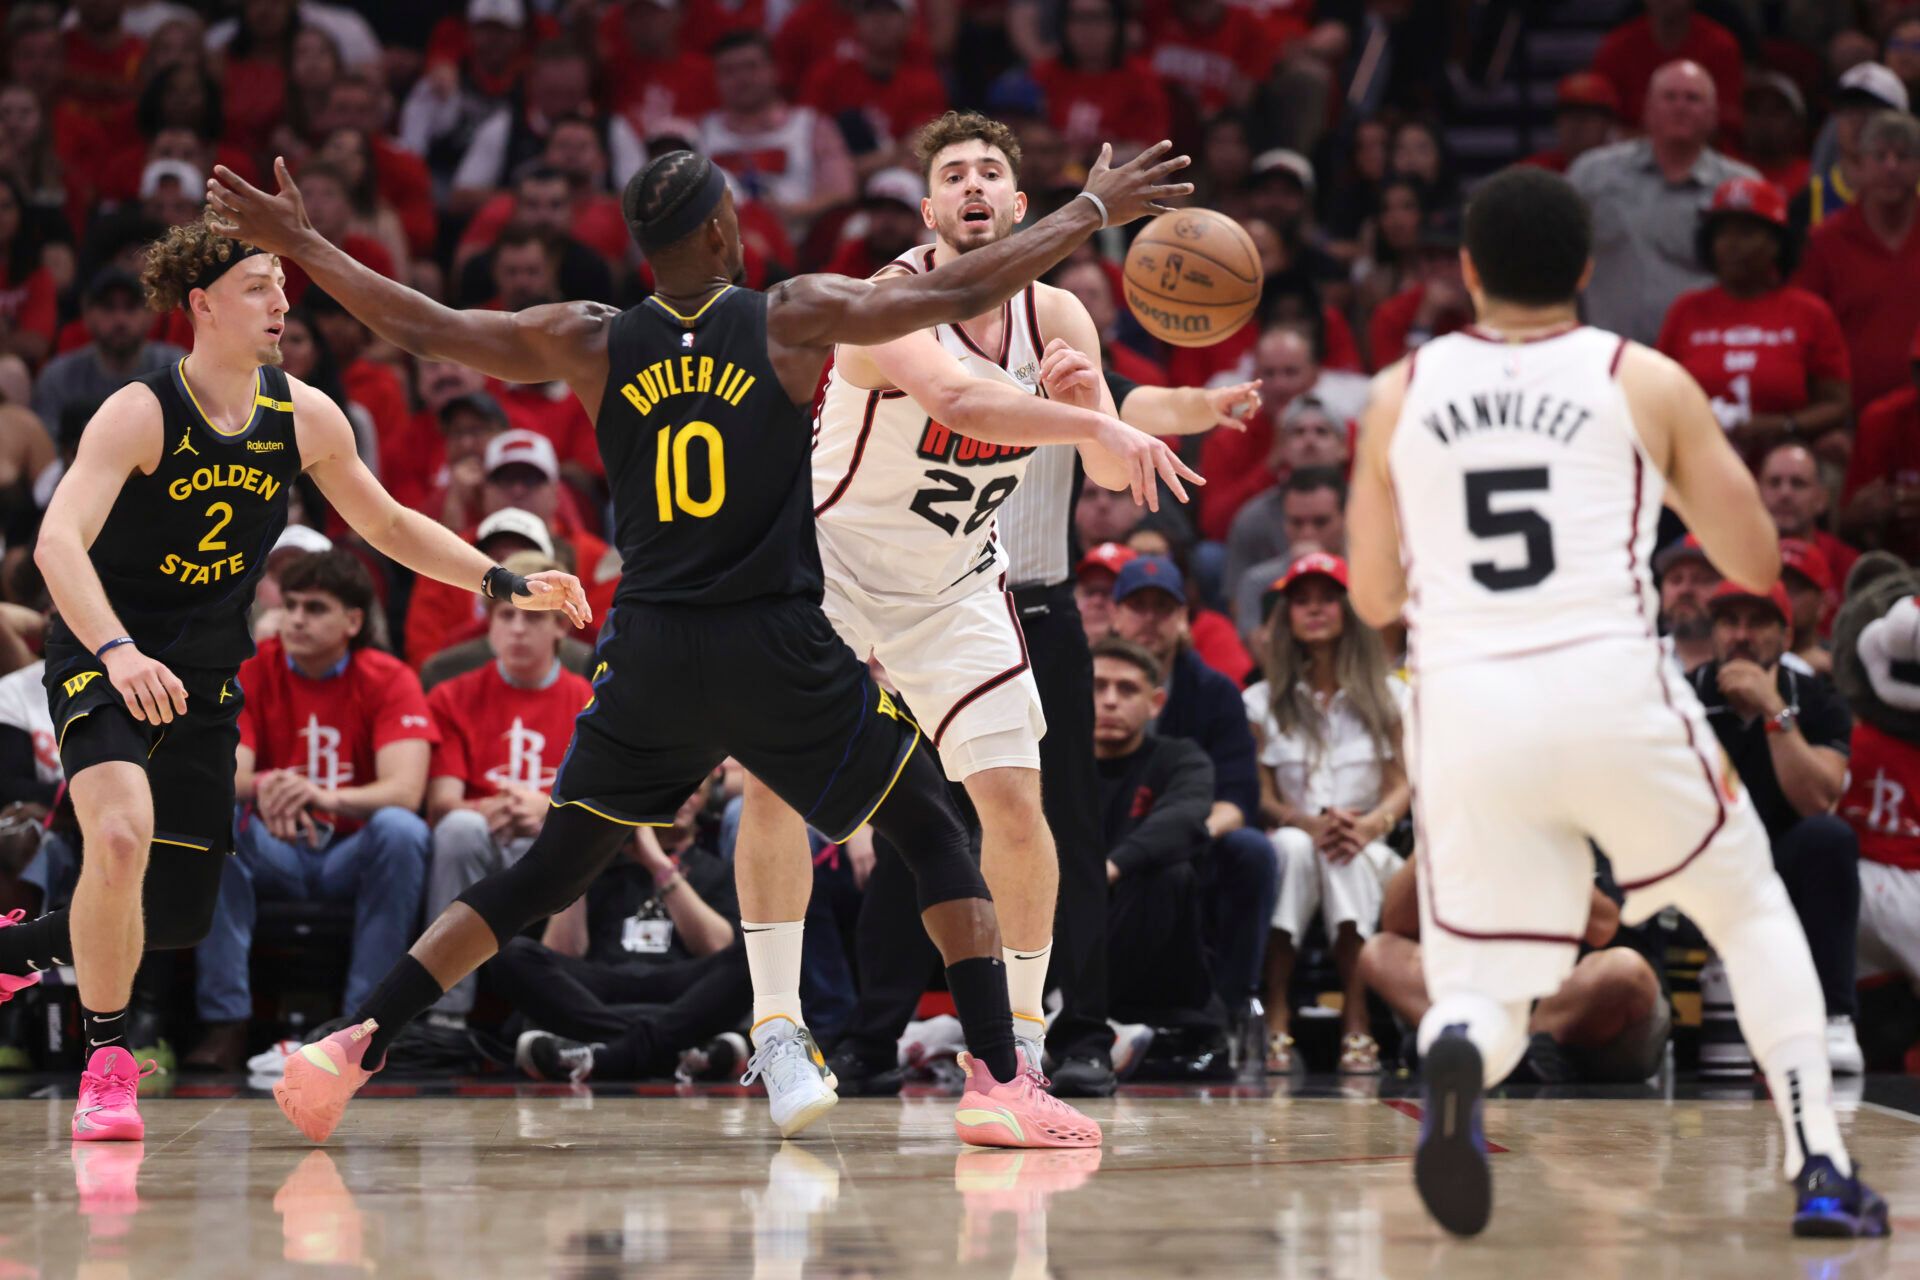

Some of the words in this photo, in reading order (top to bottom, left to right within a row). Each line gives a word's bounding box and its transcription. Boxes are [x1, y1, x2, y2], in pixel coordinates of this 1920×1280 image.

[620, 356, 714, 416] BUTLER
[714, 362, 756, 407] III
[1422, 390, 1592, 445] VANVLEET
[246, 440, 284, 452] Rakuten
[655, 420, 727, 522] 10
[168, 464, 281, 501] GOLDEN
[908, 468, 1019, 538] 28
[198, 501, 234, 552] 2
[1463, 465, 1557, 593] 5
[159, 552, 245, 585] STATE
